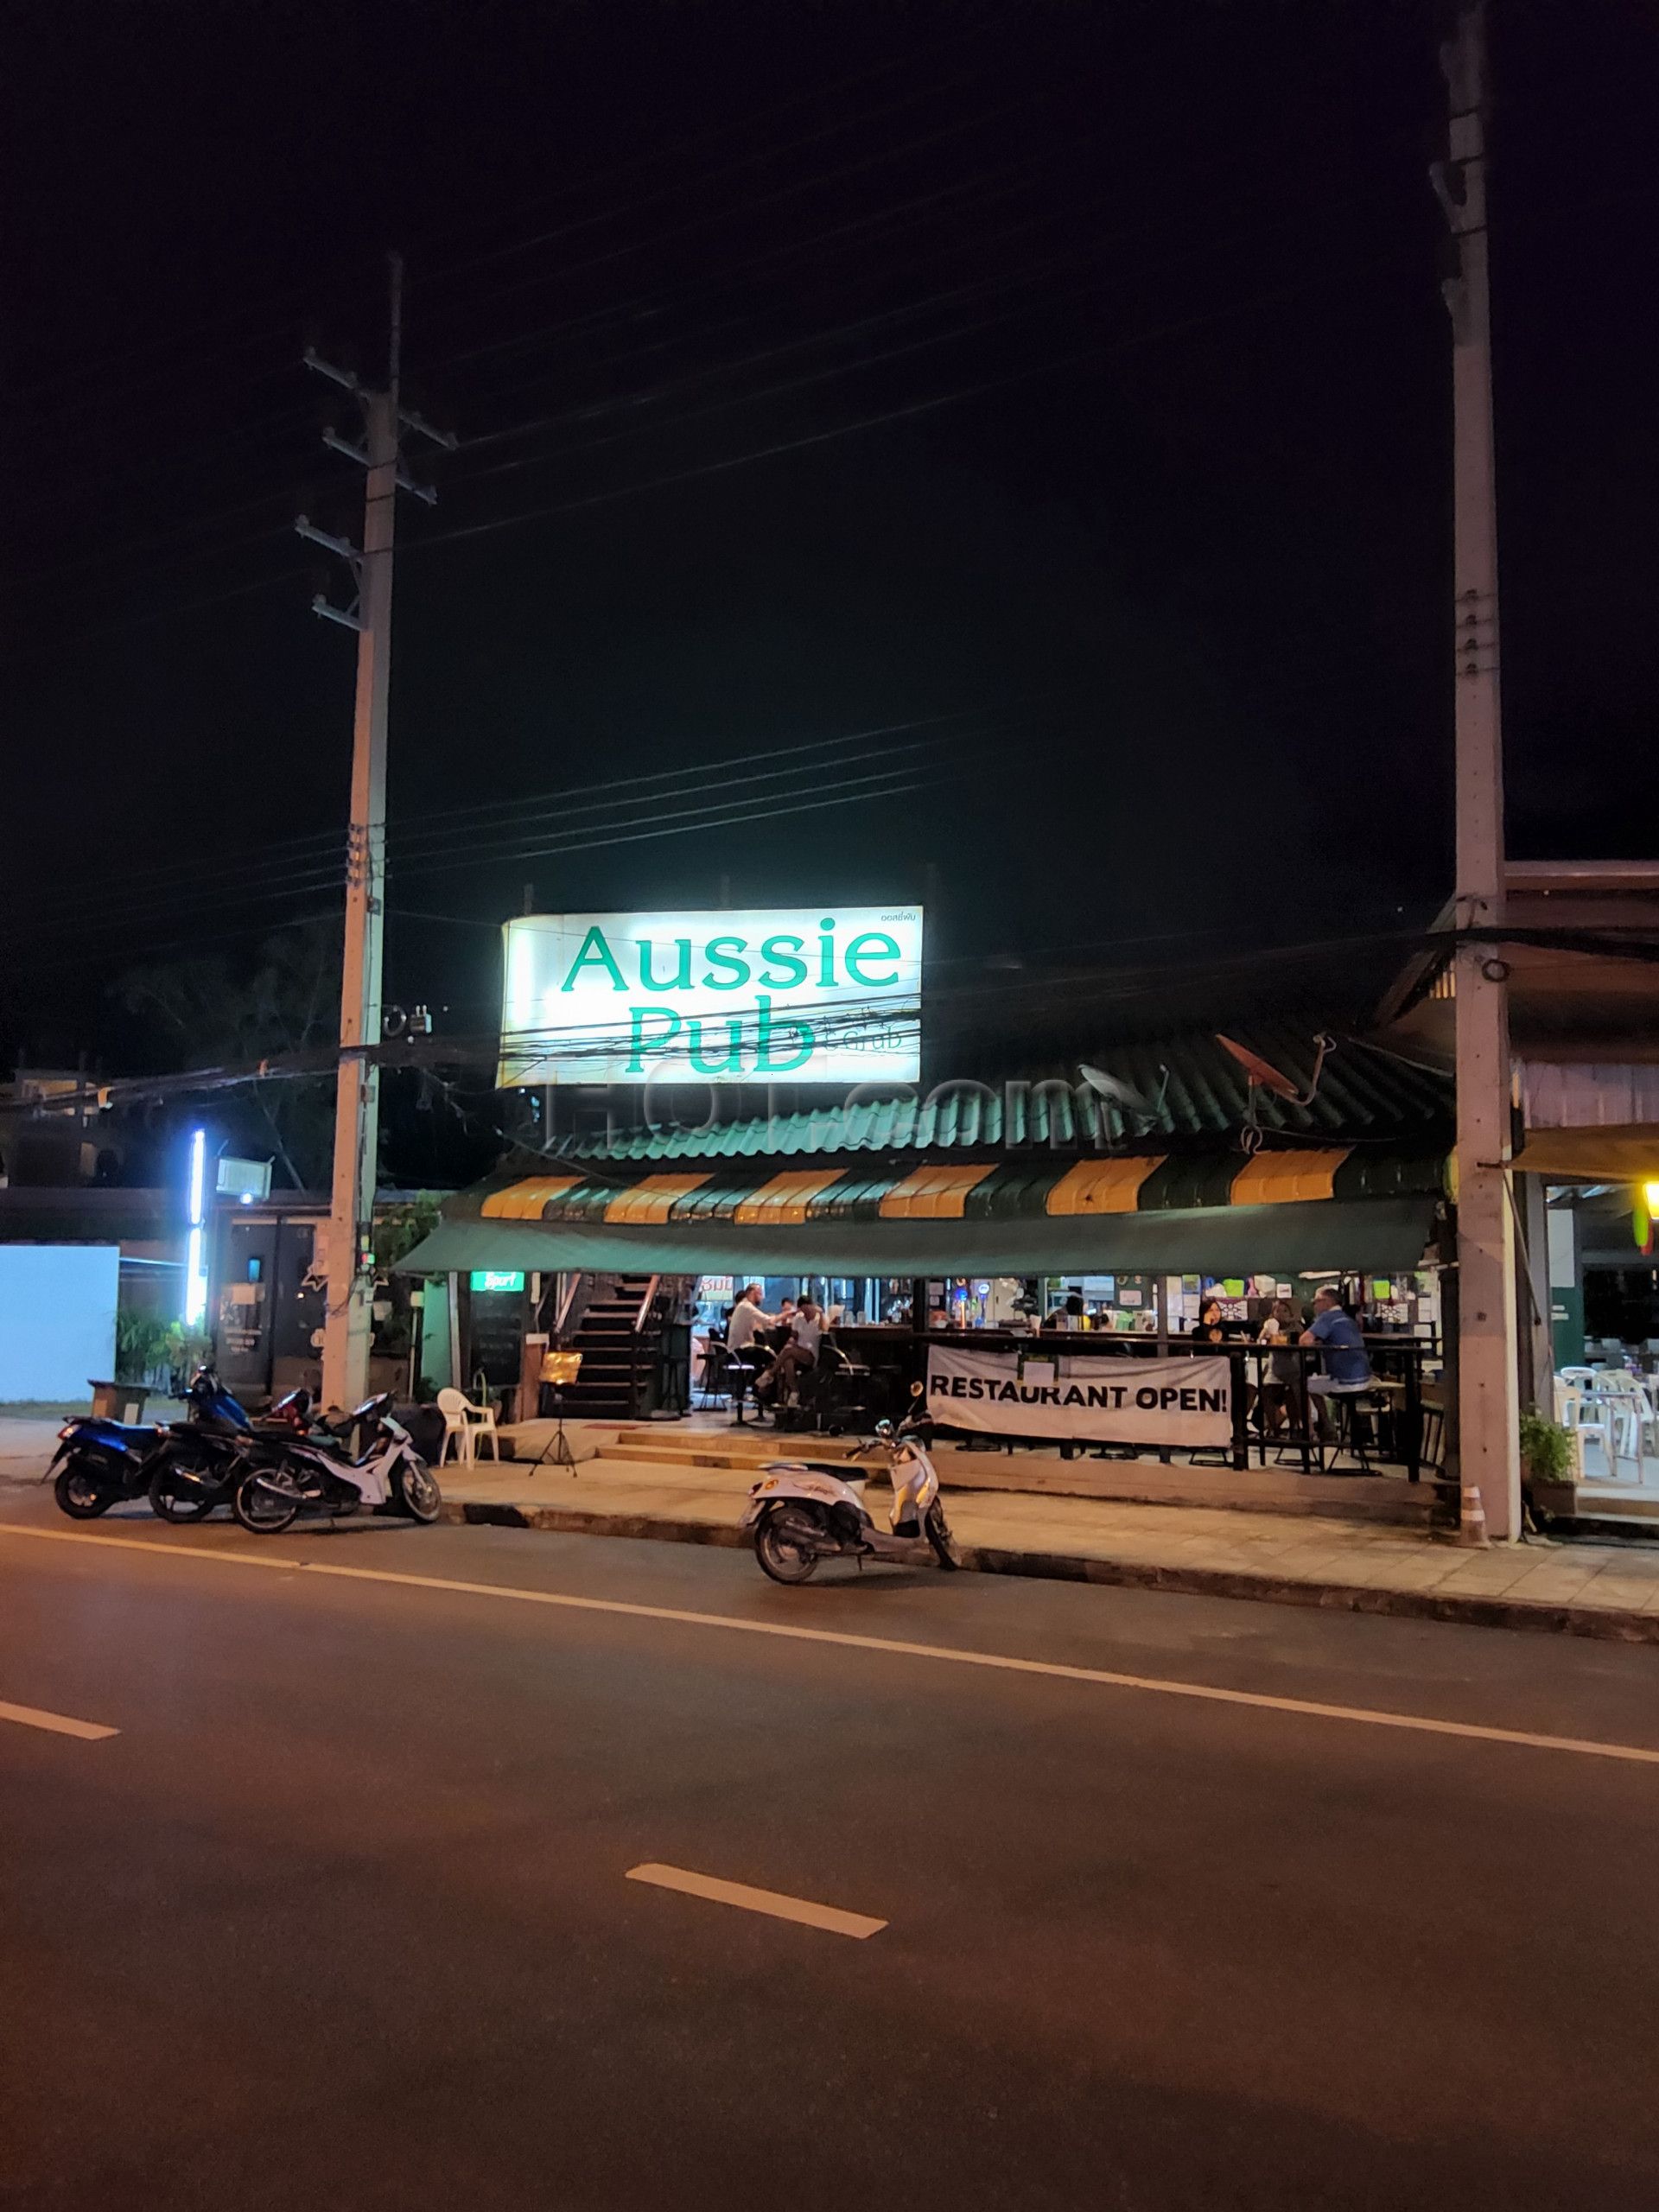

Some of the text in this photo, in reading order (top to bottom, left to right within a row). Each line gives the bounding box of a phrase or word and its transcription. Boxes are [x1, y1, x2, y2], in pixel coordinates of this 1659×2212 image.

[561, 917, 901, 992] Aussie
[625, 995, 817, 1074] Pub
[930, 1375, 1228, 1413] RESTAURANT OPEN!
